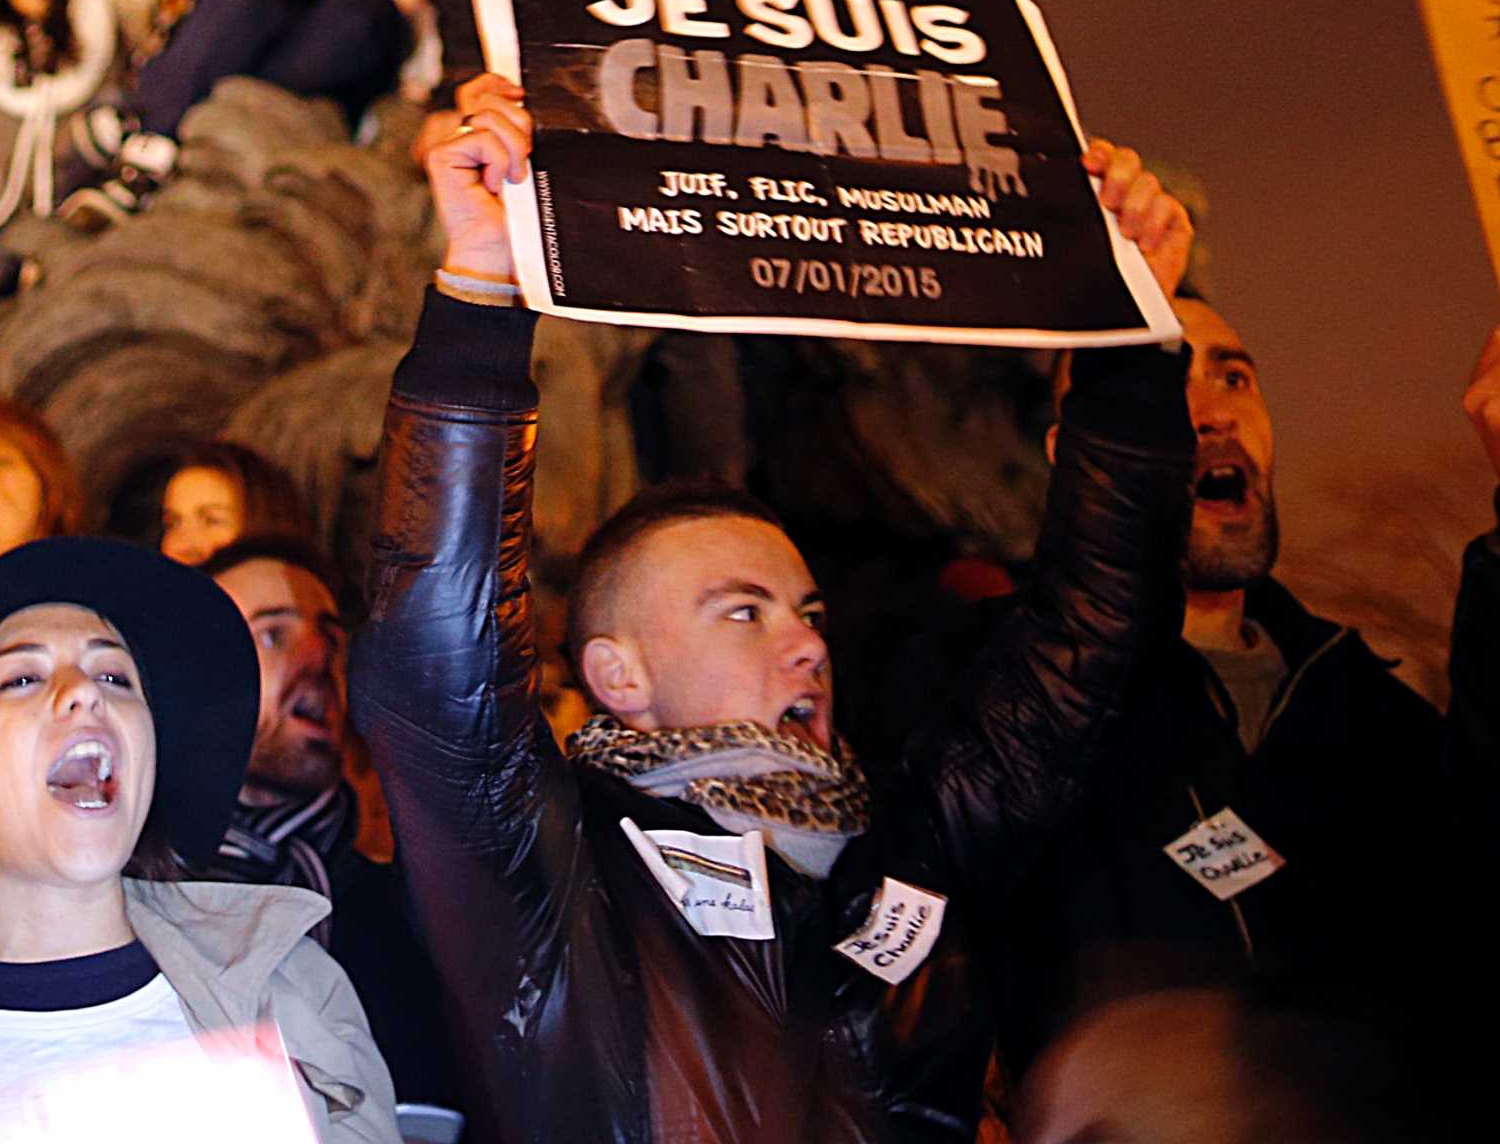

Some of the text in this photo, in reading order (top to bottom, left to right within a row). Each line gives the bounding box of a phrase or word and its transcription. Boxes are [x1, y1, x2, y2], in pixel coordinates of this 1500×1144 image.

[600, 38, 1028, 201] CHARLIE
[834, 185, 992, 219] MUSULMAN
[616, 206, 1045, 259] MAIS SURTOUT REPUBLICAIN
[749, 257, 942, 300] 07/01/2015
